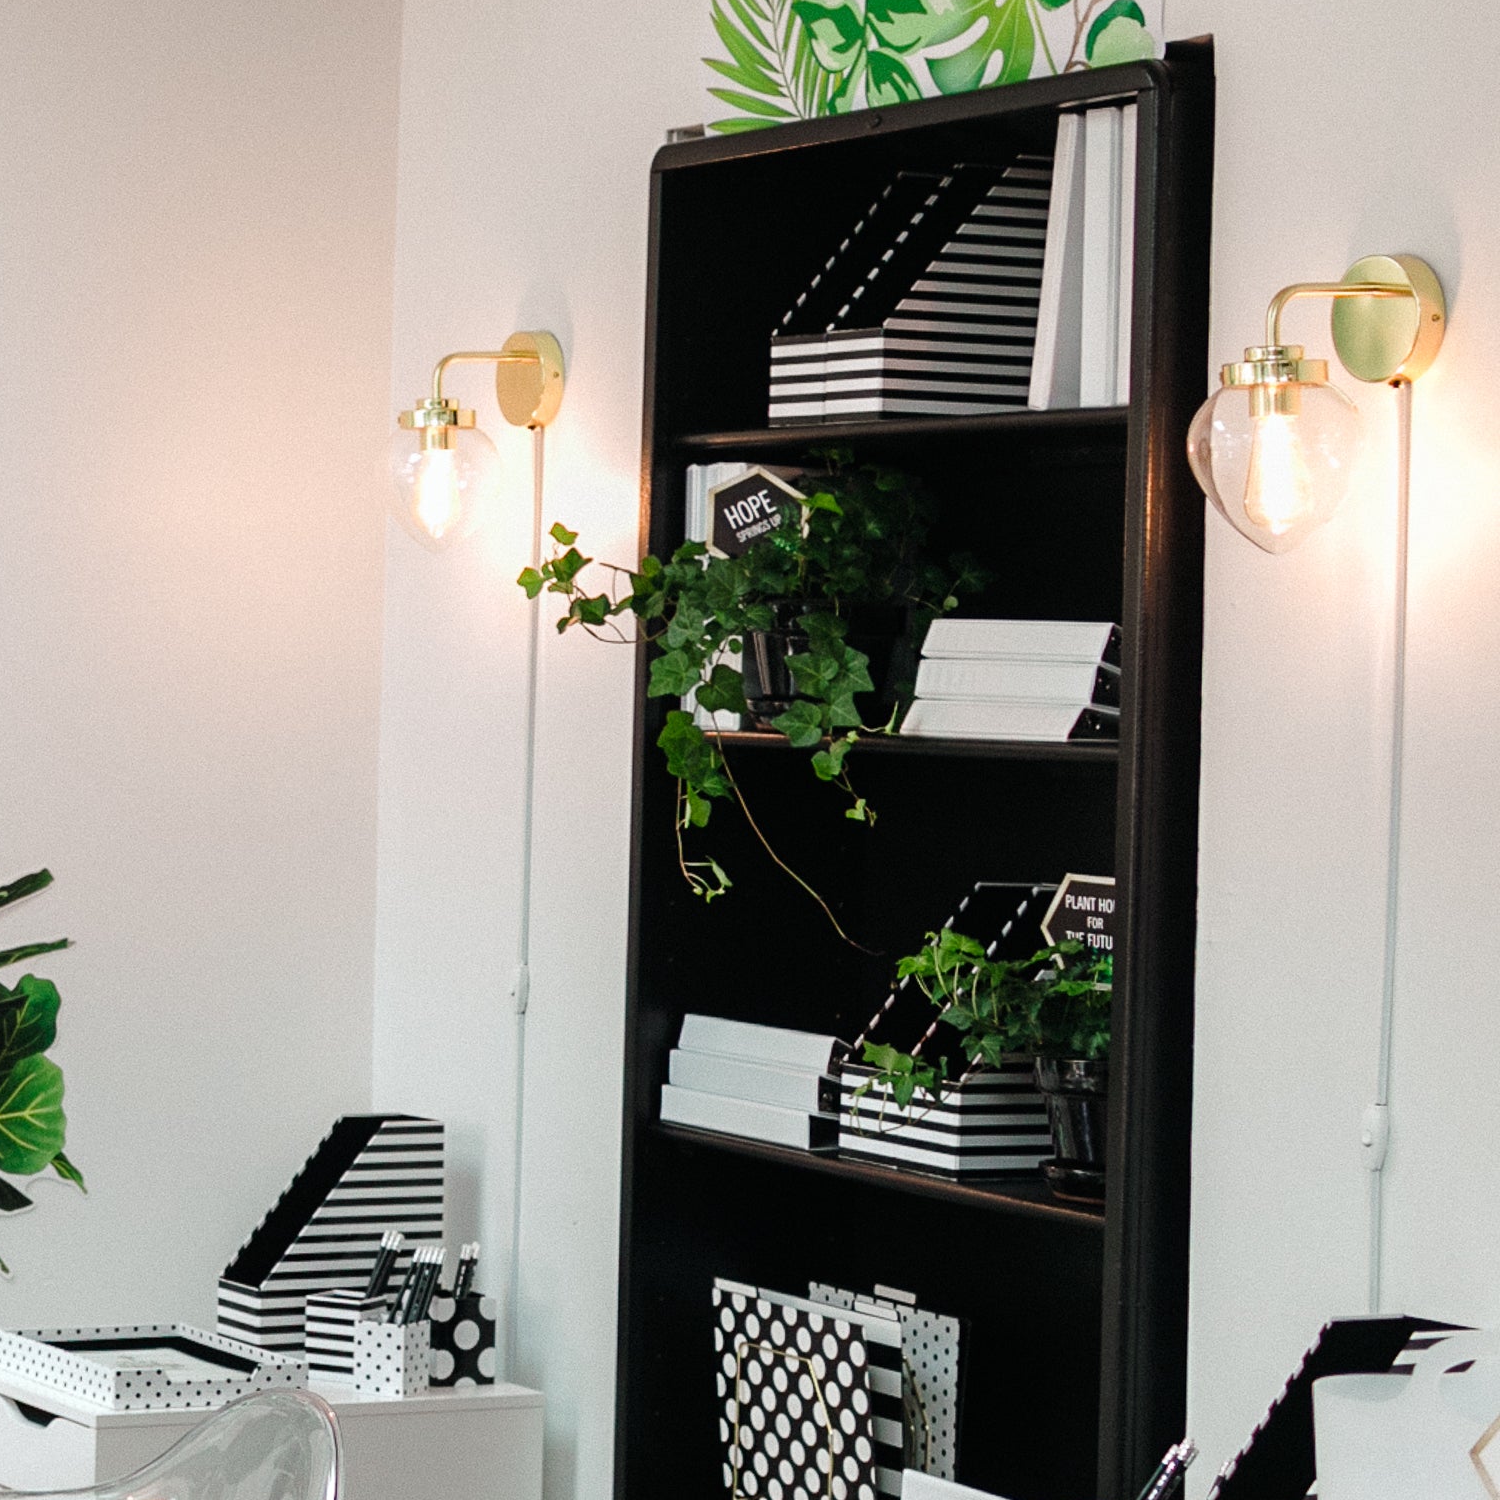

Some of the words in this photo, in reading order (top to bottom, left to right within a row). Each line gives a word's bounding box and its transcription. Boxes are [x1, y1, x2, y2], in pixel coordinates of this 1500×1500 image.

[724, 489, 777, 529] HOPE
[736, 519, 770, 542] SPRINGS
[769, 513, 781, 528] UP
[1065, 894, 1097, 911] PLANT
[1086, 916, 1104, 929] FOR
